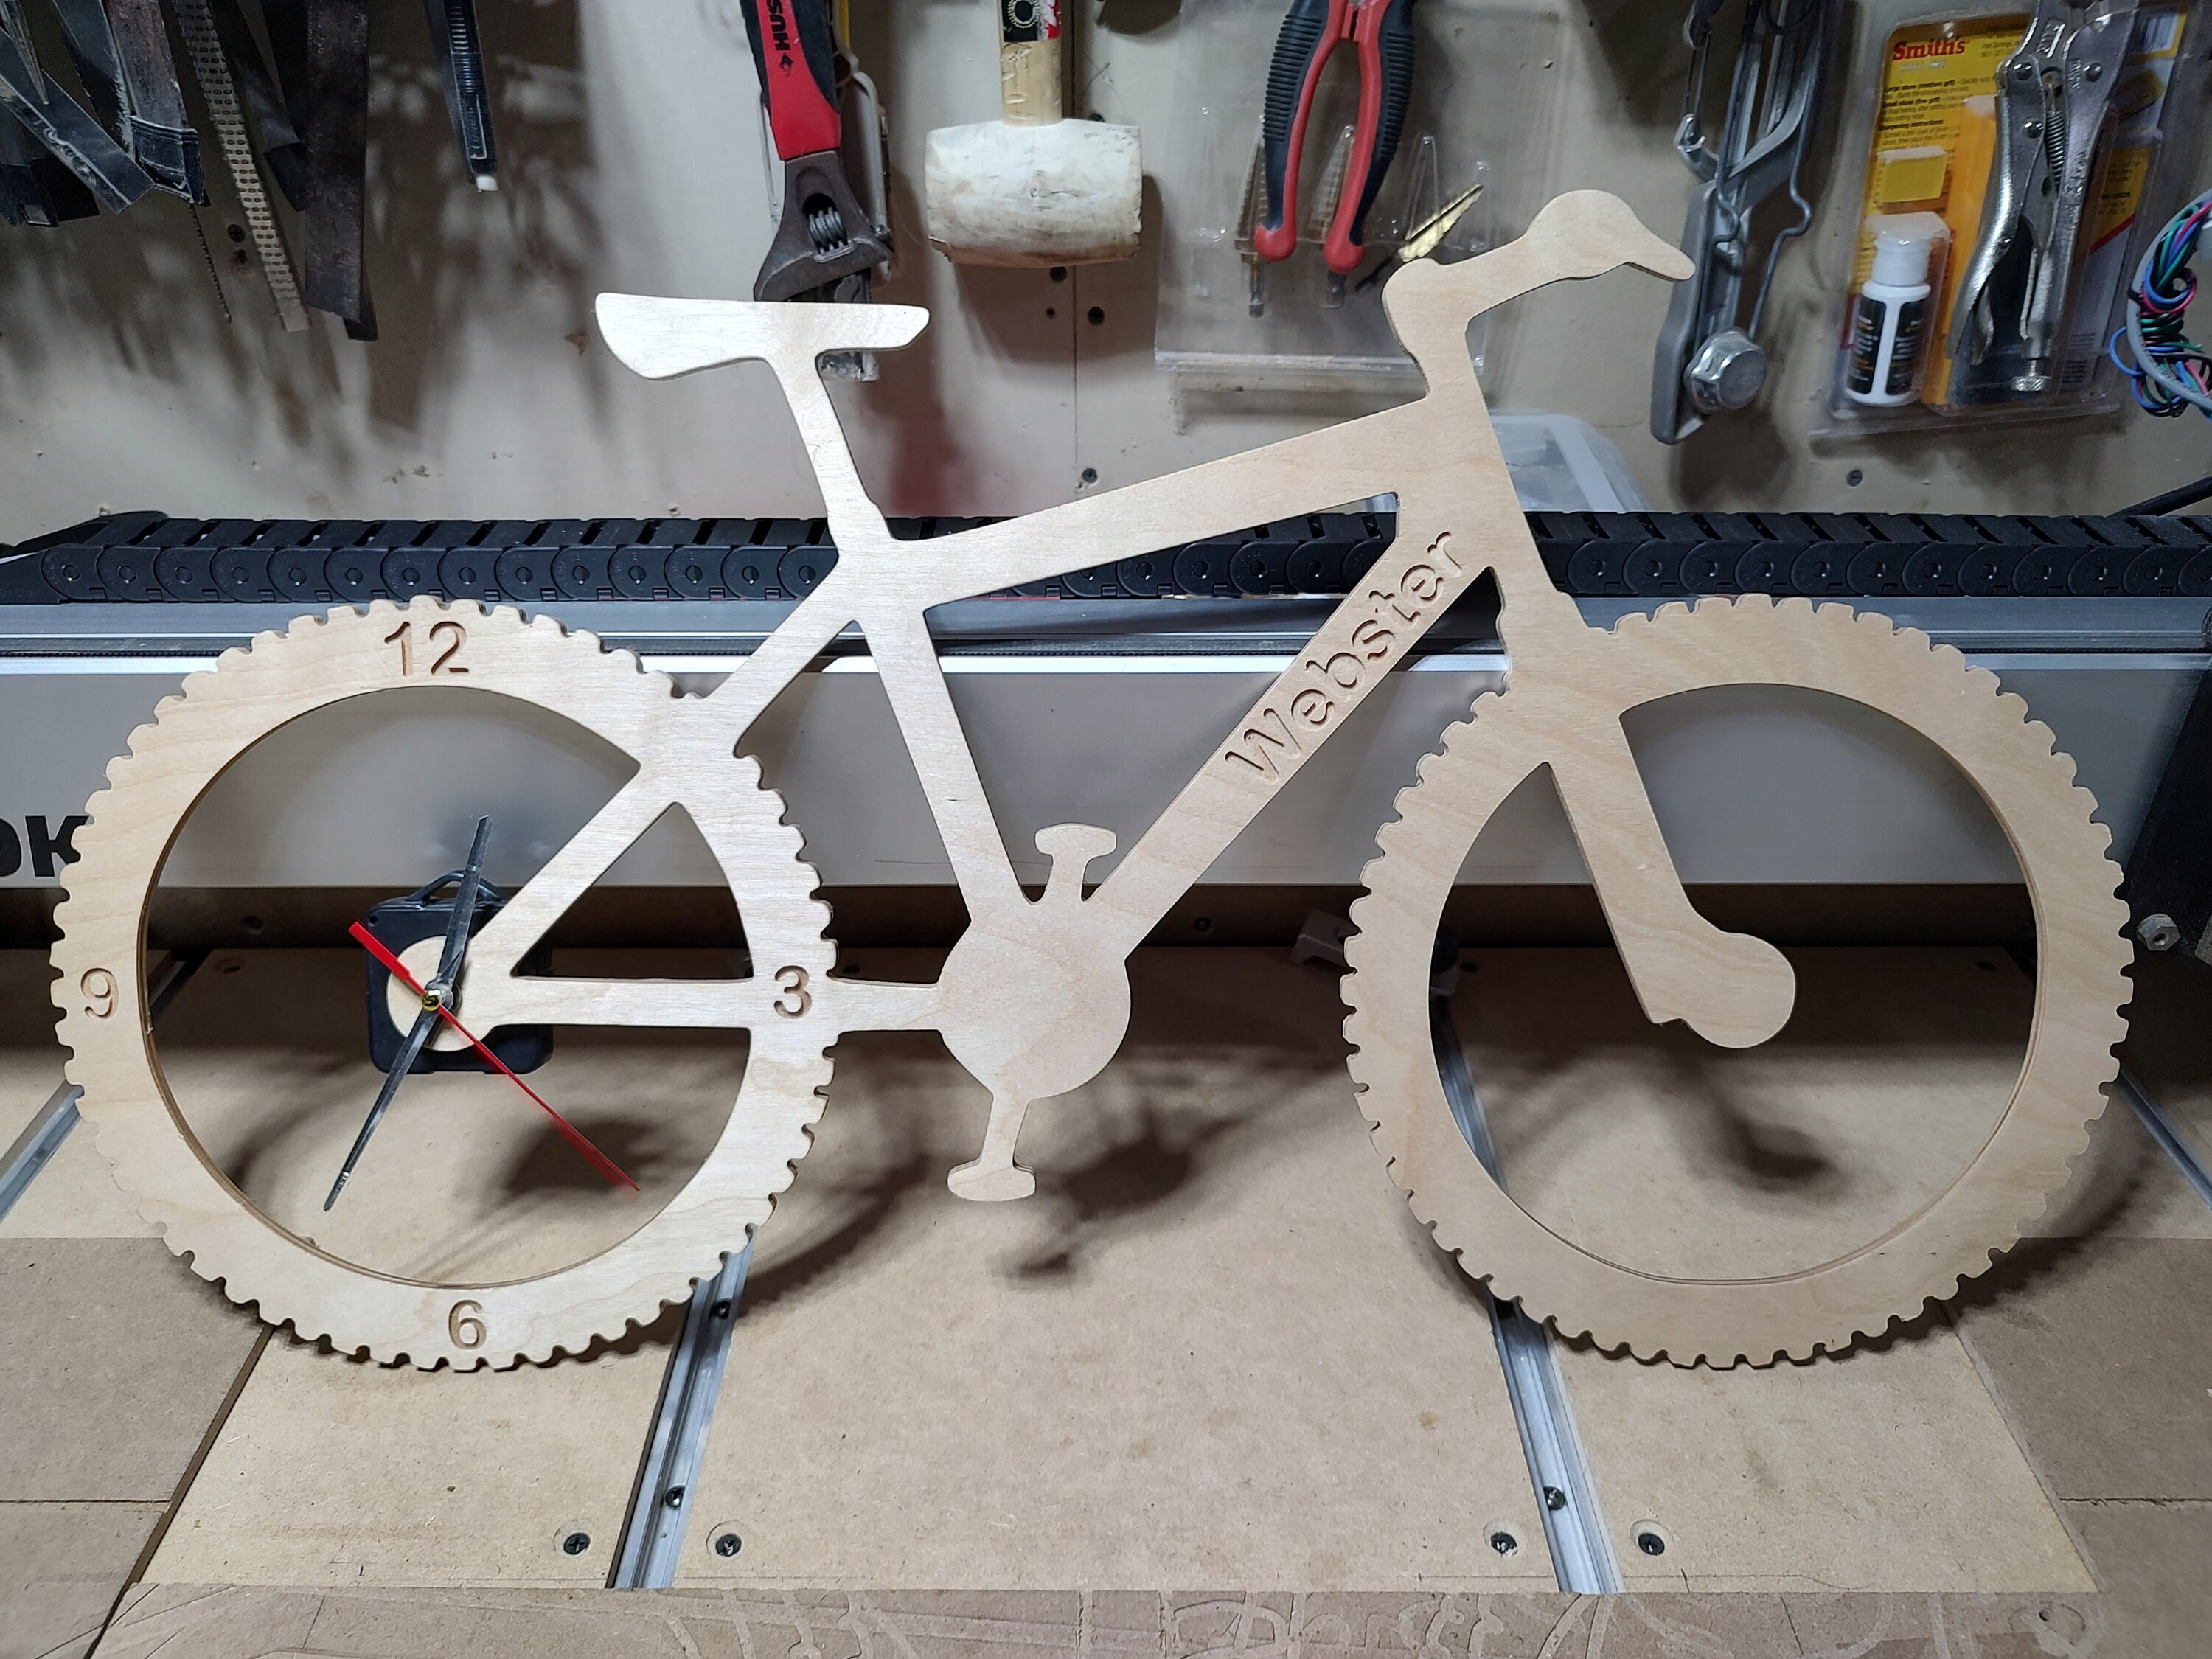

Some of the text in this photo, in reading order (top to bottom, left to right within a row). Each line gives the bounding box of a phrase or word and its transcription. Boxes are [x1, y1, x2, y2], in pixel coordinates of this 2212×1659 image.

[1892, 37, 1966, 61] Smith's
[384, 621, 470, 676] 12
[1225, 531, 1463, 785] Webster
[80, 967, 119, 1020] 9
[773, 965, 812, 1019] 3
[448, 1299, 487, 1350] 6
